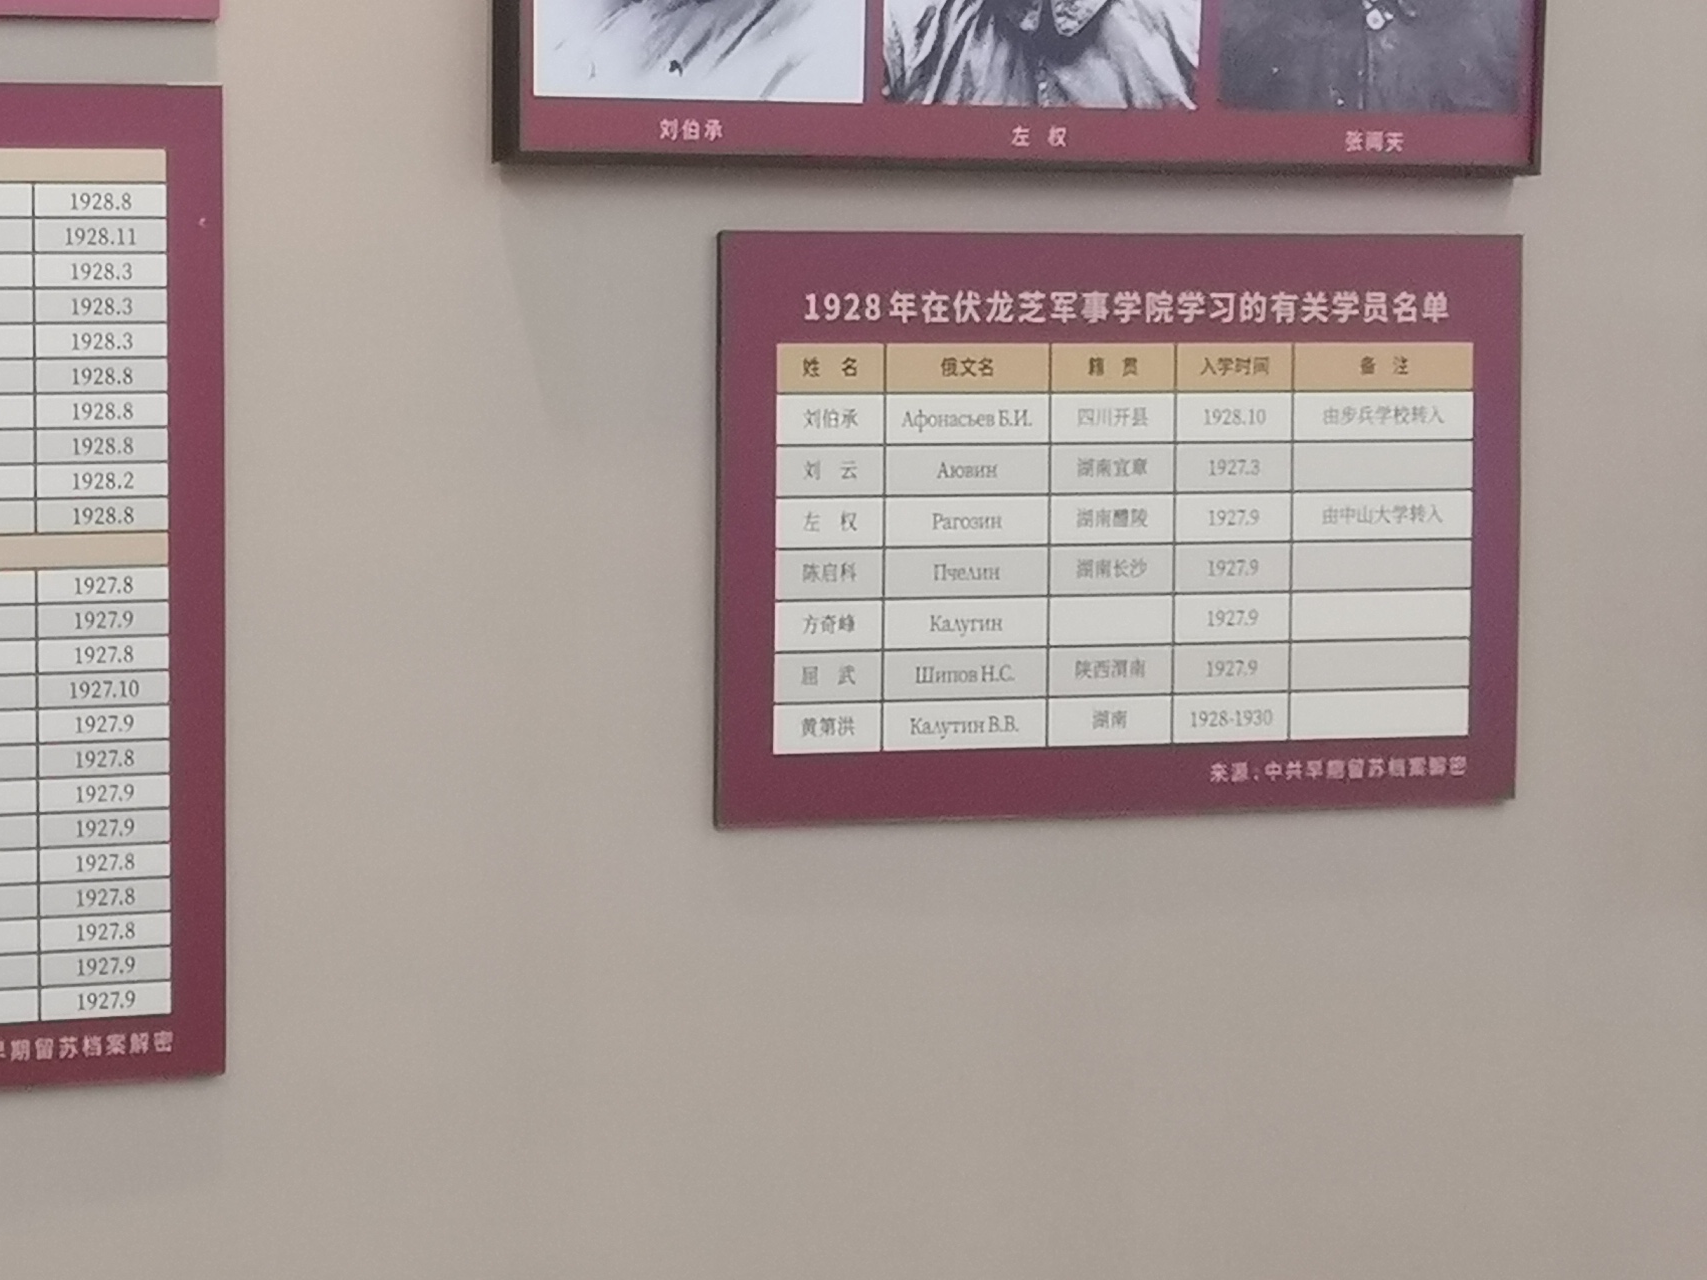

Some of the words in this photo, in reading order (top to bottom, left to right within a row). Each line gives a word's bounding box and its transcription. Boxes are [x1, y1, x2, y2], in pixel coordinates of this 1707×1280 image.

[70, 191, 132, 211] 1928.8
[65, 226, 136, 246] 1928.11
[71, 261, 133, 281] 1928.3
[71, 296, 133, 316] 1928.3
[71, 331, 133, 351] 1928.3
[72, 366, 134, 386] 1928.8
[72, 401, 134, 421] 1928.8
[1203, 407, 1267, 426] 1928.10
[72, 436, 134, 456] 1928.8
[1208, 457, 1261, 477] 1927.3
[72, 470, 134, 491] 1928.2
[72, 505, 135, 525] 1928.8
[1208, 507, 1260, 527] 1927.9
[1207, 558, 1260, 577] 1927.9
[74, 575, 134, 595] 1927.8
[74, 609, 134, 630] 1927.9
[1207, 607, 1260, 628] 1927.9
[74, 644, 134, 665] 1927.8
[1206, 658, 1258, 678] 1927.9
[70, 678, 140, 700] 1927.10
[75, 713, 135, 734] 1927.9
[1190, 708, 1273, 729] 1928-1930
[75, 748, 135, 769] 1927.8
[75, 782, 135, 804] 1927.9
[76, 817, 135, 838] 1927.9
[76, 851, 136, 873] 1927.8
[76, 886, 136, 908] 1927.8
[76, 920, 136, 942] 1927.8
[77, 955, 136, 977] 1927.9
[77, 989, 136, 1011] 1927.9
